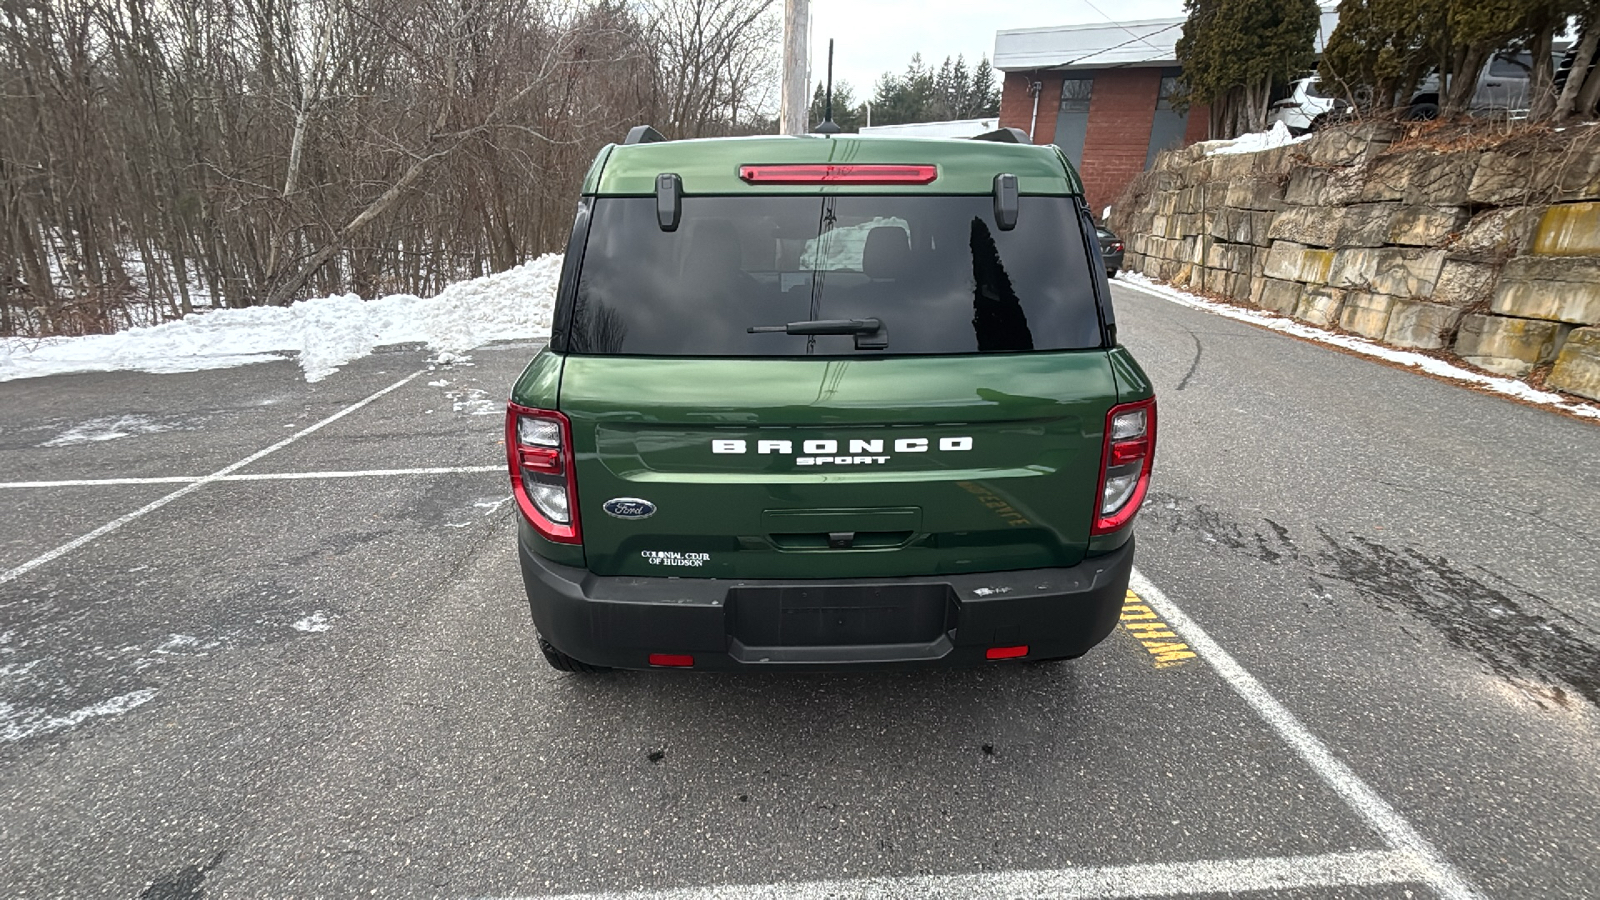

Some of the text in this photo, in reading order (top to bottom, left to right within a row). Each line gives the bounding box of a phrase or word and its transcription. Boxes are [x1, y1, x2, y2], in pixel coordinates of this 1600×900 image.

[712, 437, 973, 454] BRONCO
[796, 455, 891, 466] SPORT
[614, 502, 644, 515] Ford
[641, 550, 711, 561] COLONIAL CDJR
[648, 557, 703, 567] OF HUDSON
